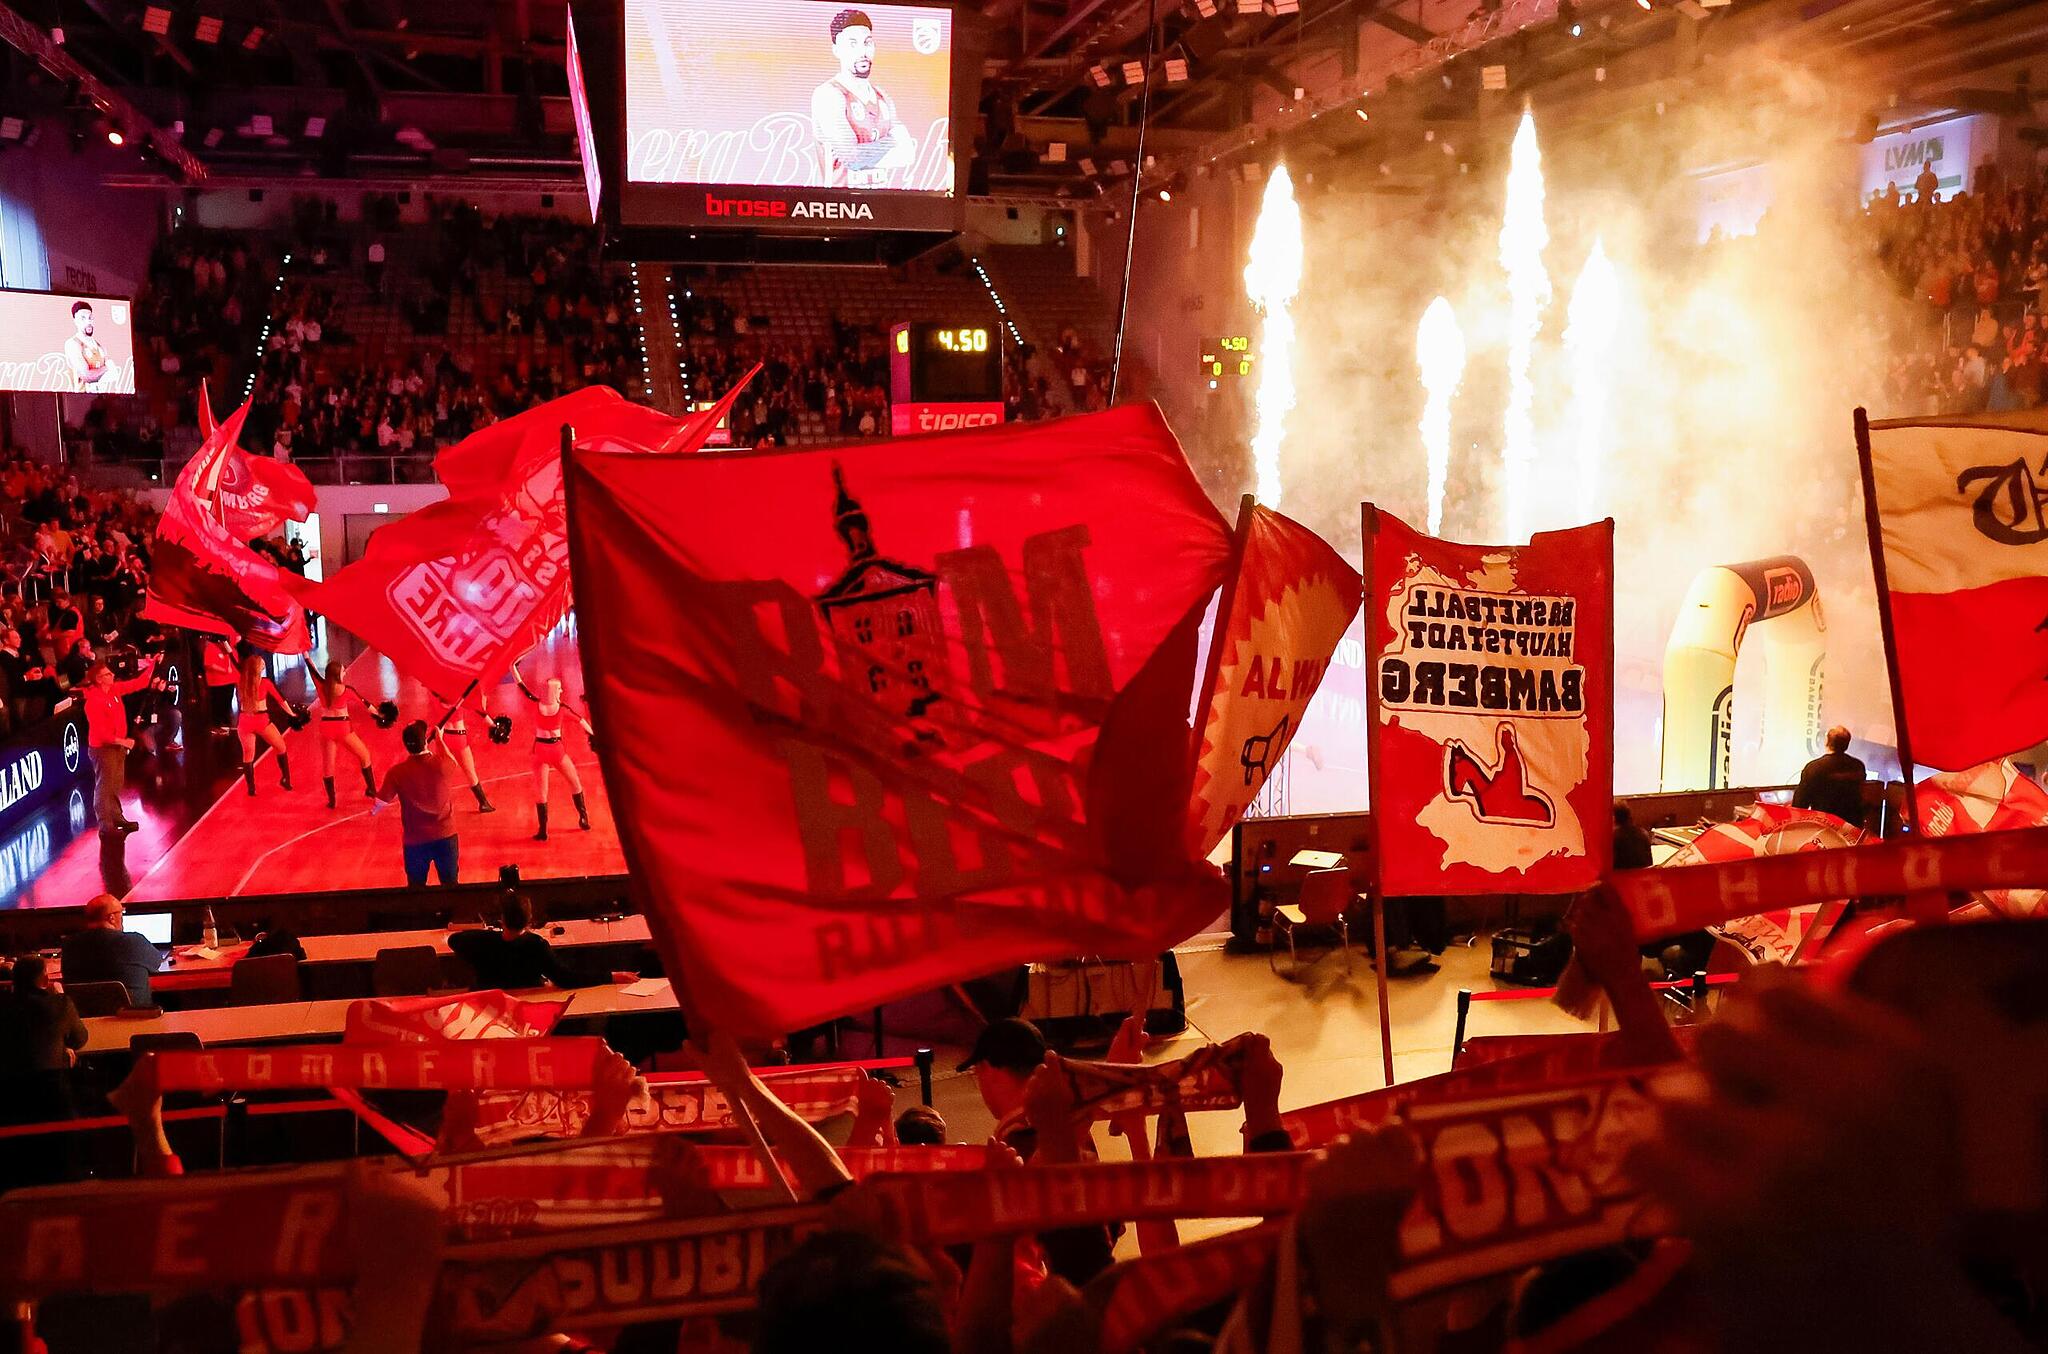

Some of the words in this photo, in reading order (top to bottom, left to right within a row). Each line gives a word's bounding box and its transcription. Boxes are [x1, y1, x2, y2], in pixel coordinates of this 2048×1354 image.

[706, 193, 786, 217] brose
[791, 201, 873, 219] ARENA
[1773, 575, 1800, 604] radio
[0, 750, 43, 812] LAND
